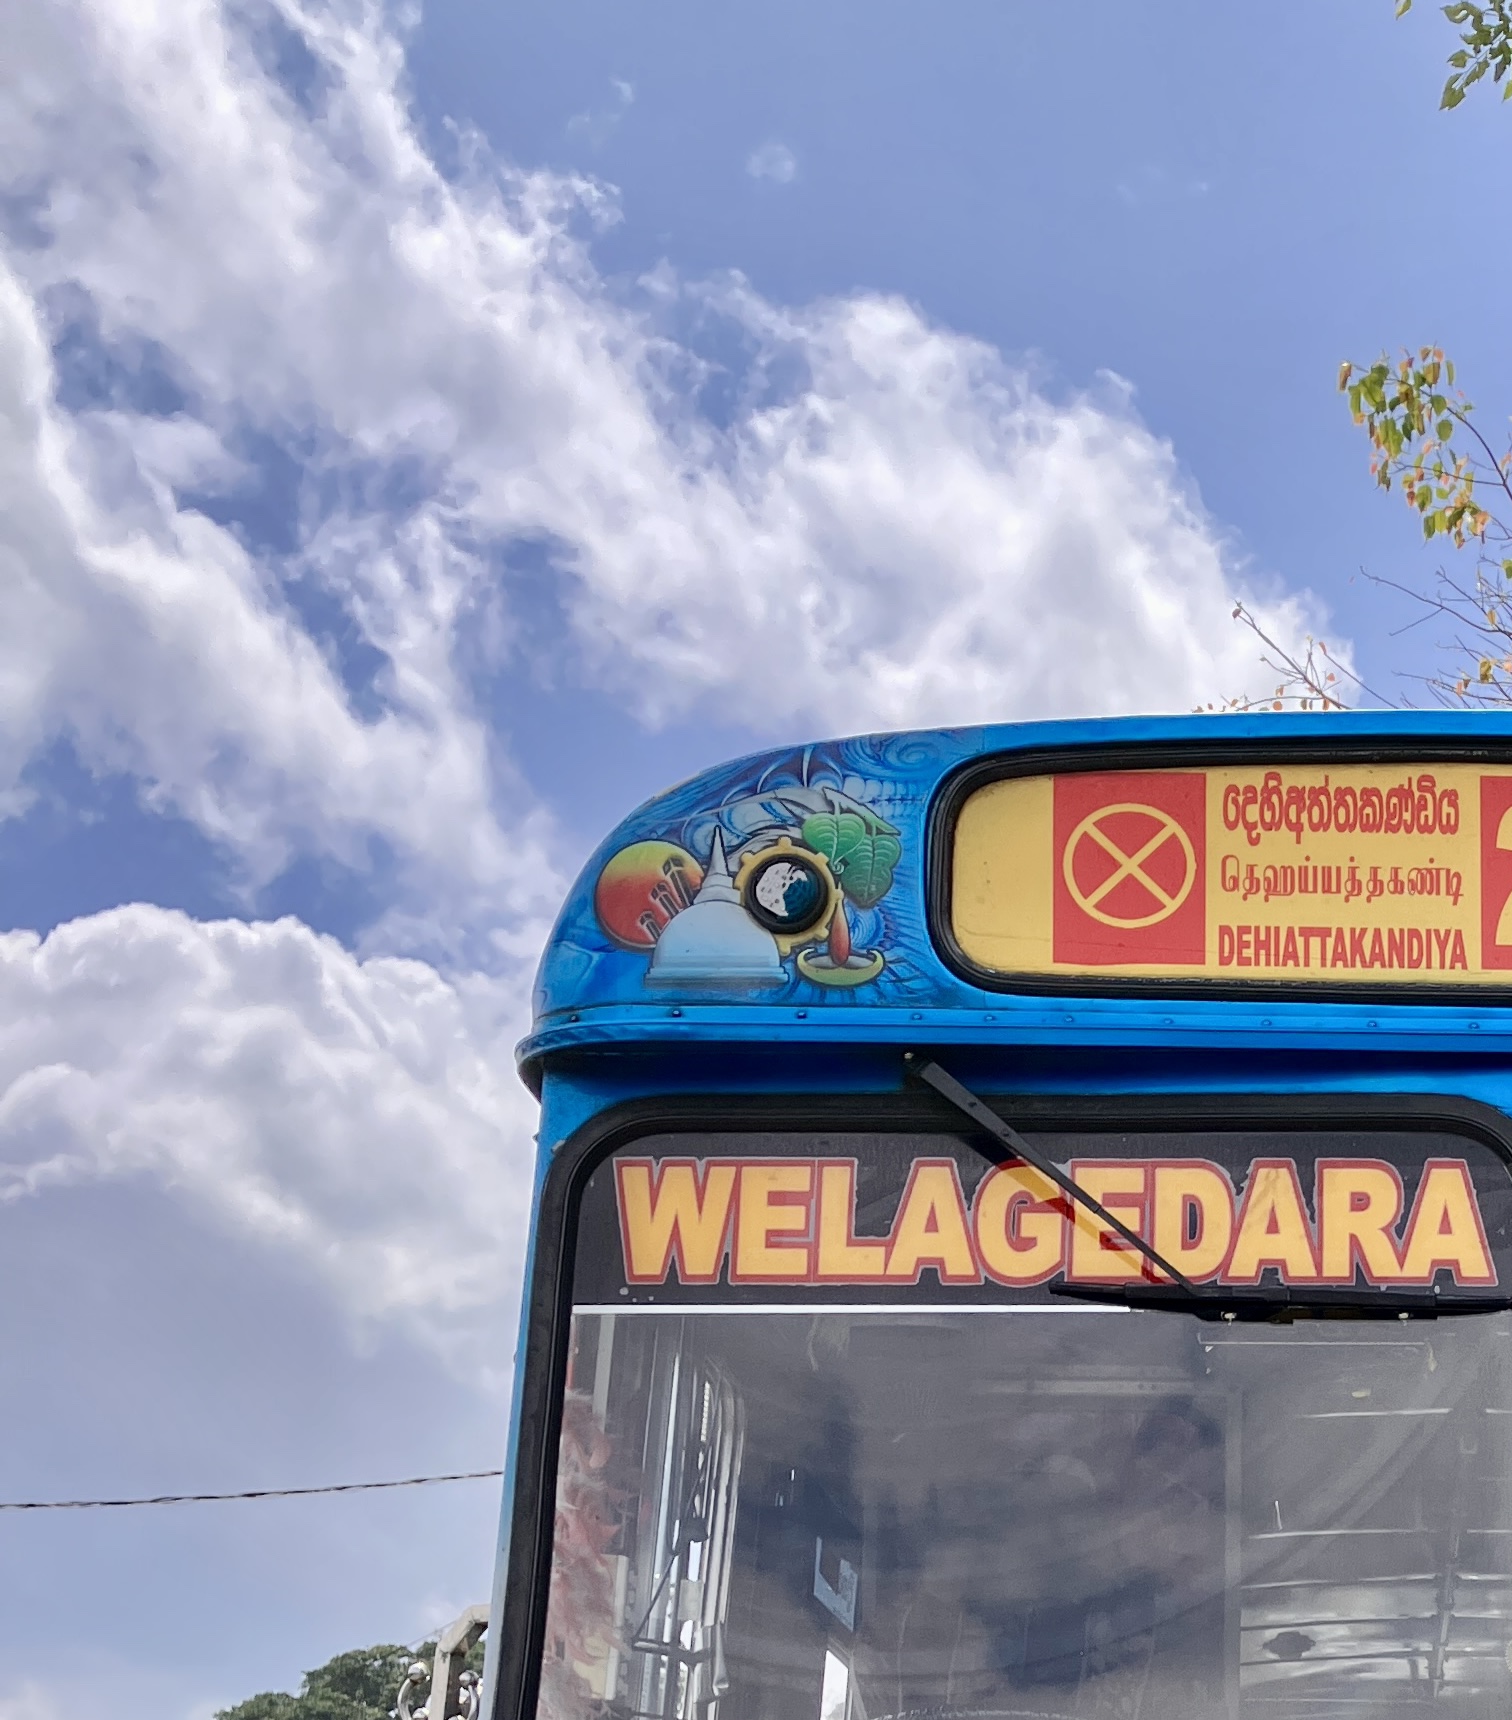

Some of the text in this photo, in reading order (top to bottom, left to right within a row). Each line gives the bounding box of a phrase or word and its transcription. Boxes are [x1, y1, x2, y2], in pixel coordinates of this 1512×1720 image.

[1222, 771, 1460, 846] දෙහිඅත්තකණ්ඩිය
[1218, 925, 1468, 970] DEHIATTAKANDIYA
[613, 1156, 1498, 1287] WELAGEDARA
